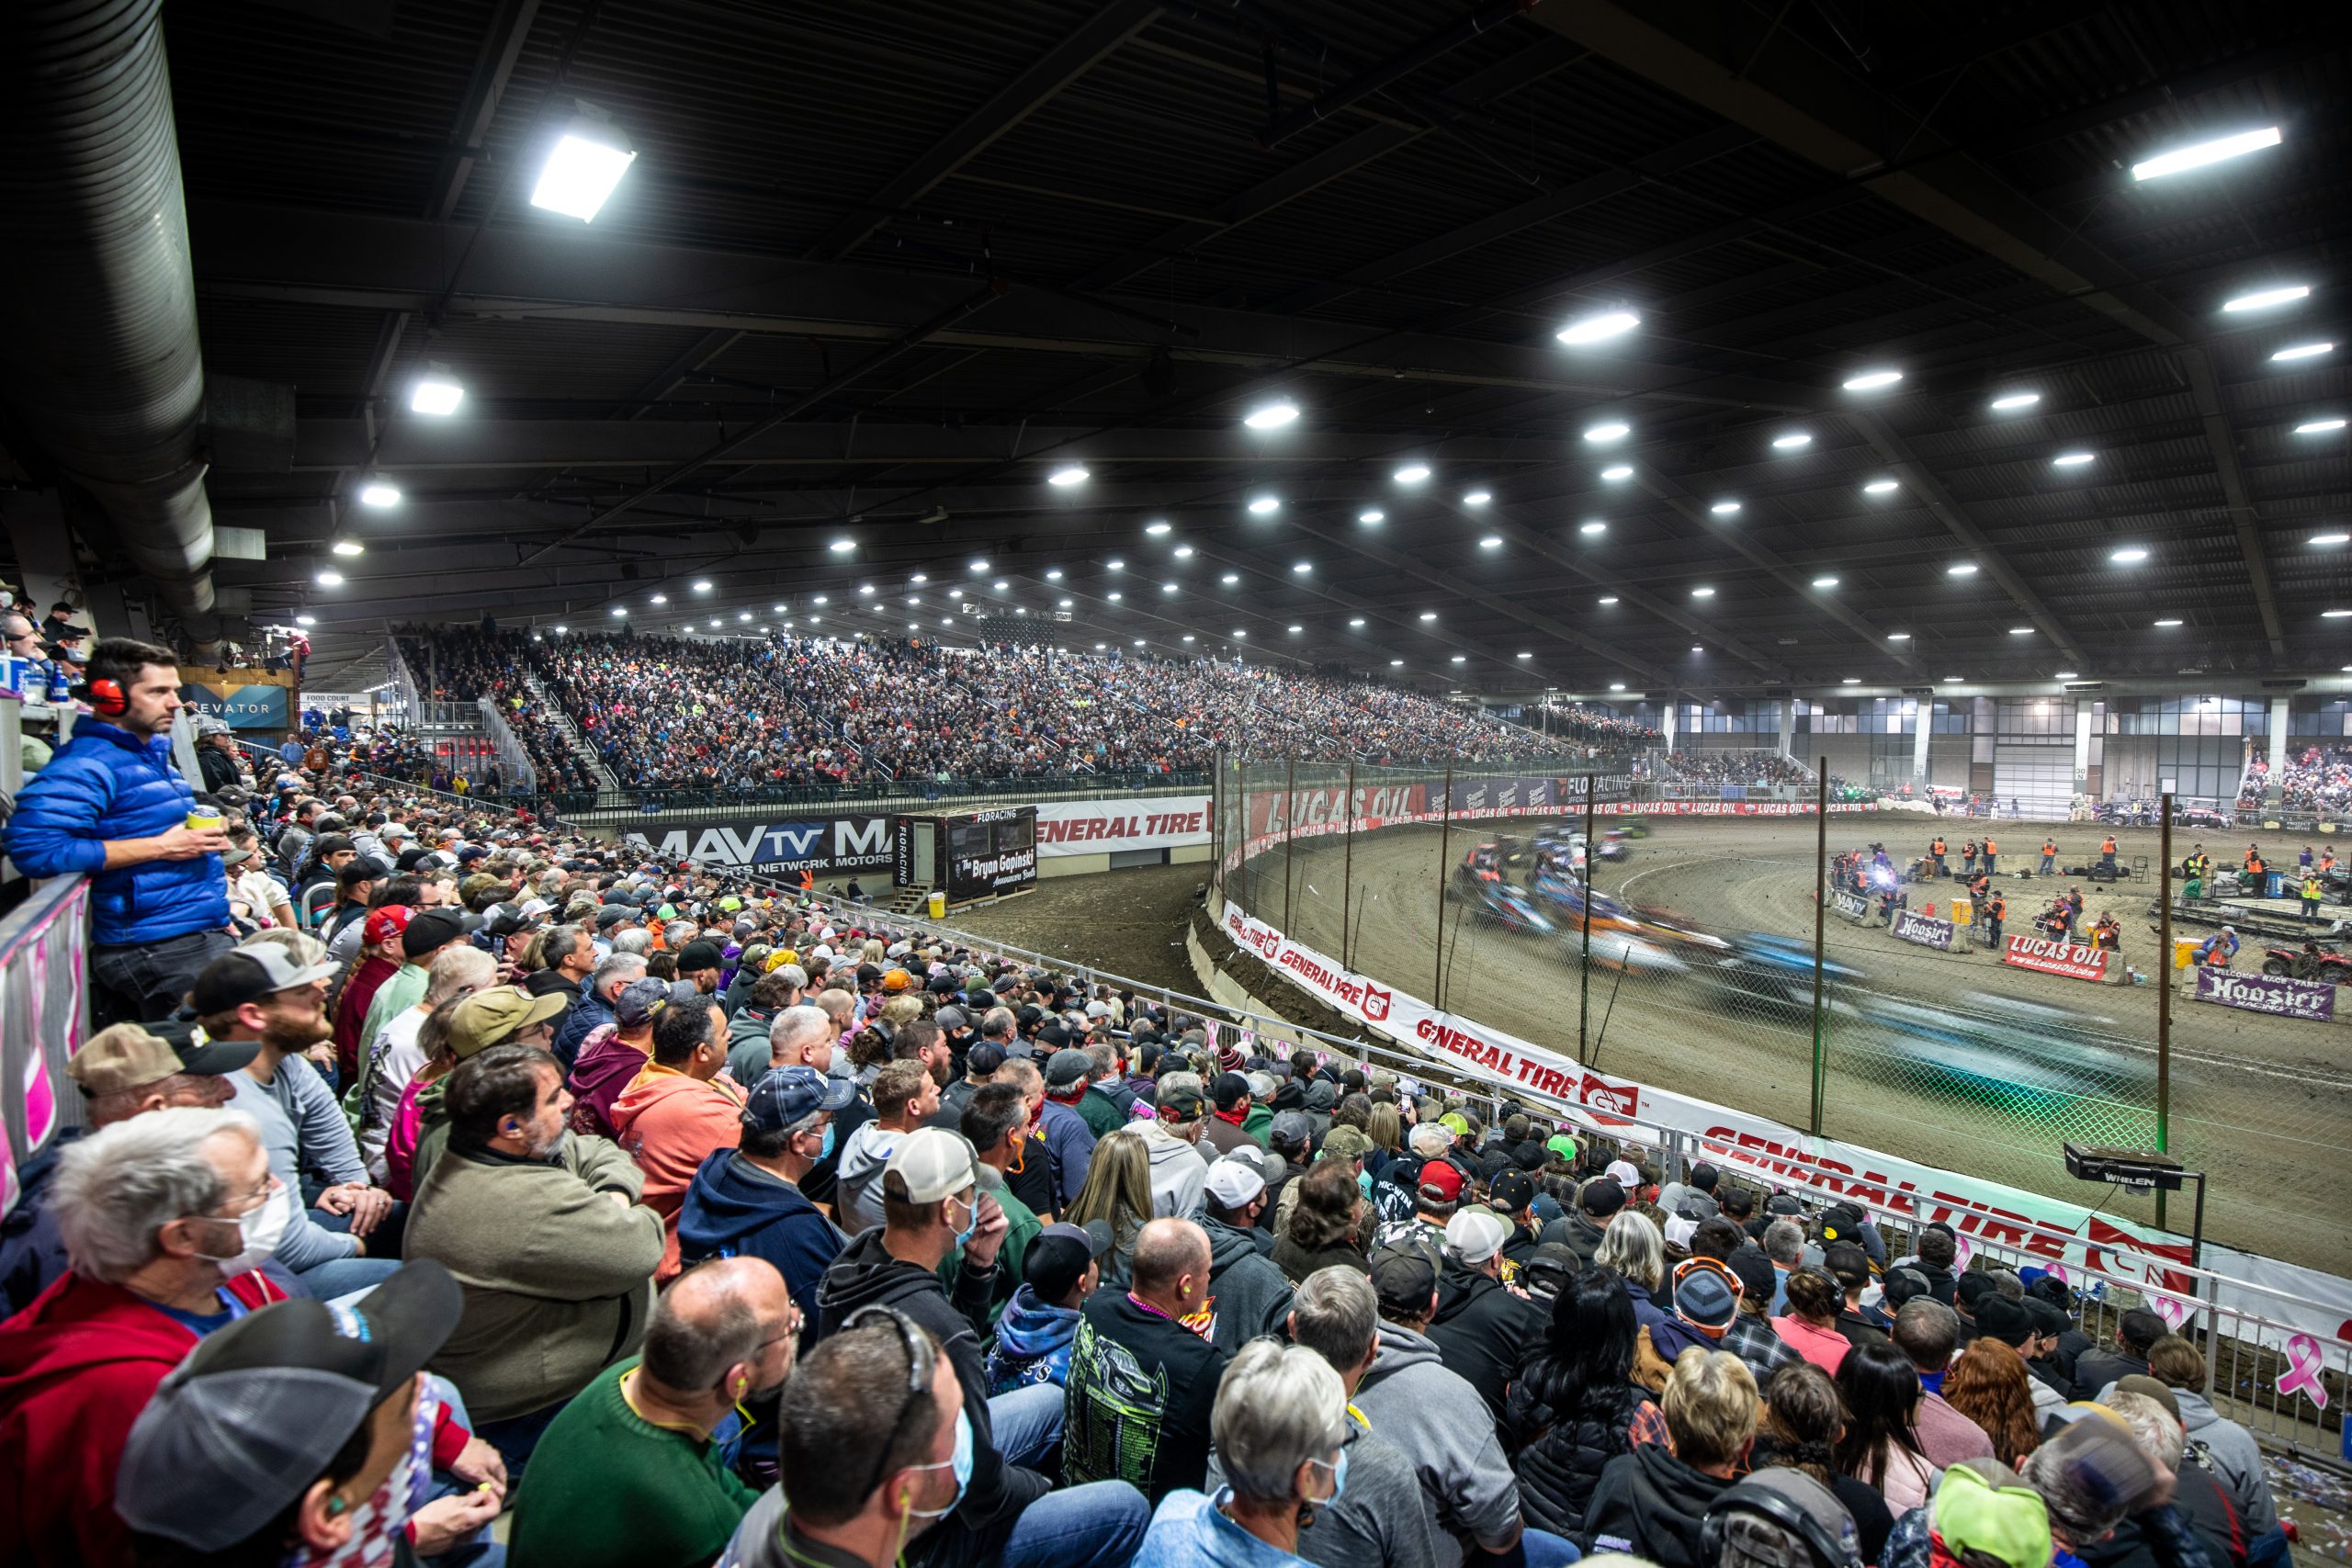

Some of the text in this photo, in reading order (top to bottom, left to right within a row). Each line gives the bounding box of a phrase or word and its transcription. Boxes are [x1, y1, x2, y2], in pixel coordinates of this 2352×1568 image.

[977, 808, 1017, 824] FLORACING
[1264, 786, 1413, 833] LUCAS OIL
[1472, 807, 1510, 819] LUCAS OIL
[1550, 806, 1562, 816] OIL
[1604, 803, 1618, 814] OIL
[1633, 802, 1676, 814] LUCAS OIL
[1692, 803, 1736, 814] LUCAS OIL
[1758, 803, 1804, 814] LUCAS OIL
[1036, 812, 1204, 843] ENERAL TIRE
[899, 826, 908, 885] FLORACING
[961, 849, 1035, 879] The Bryan Gapinski
[758, 858, 830, 874] NETWORK
[1247, 928, 1266, 948] TIRE
[1898, 917, 1950, 941] Hoosier
[2010, 936, 2103, 967] LUCAS OIL
[1279, 949, 1334, 991] GENERAL
[2010, 954, 2098, 977] www.LucasOil.com
[2212, 968, 2321, 988] WELCOME RACE FANS
[2203, 976, 2326, 1010] Hoosier
[2236, 1000, 2284, 1012] RACING
[1516, 1057, 1578, 1099] TIRE
[2104, 1172, 2155, 1187] WHELEN
[1929, 1190, 2078, 1259] TIRE
